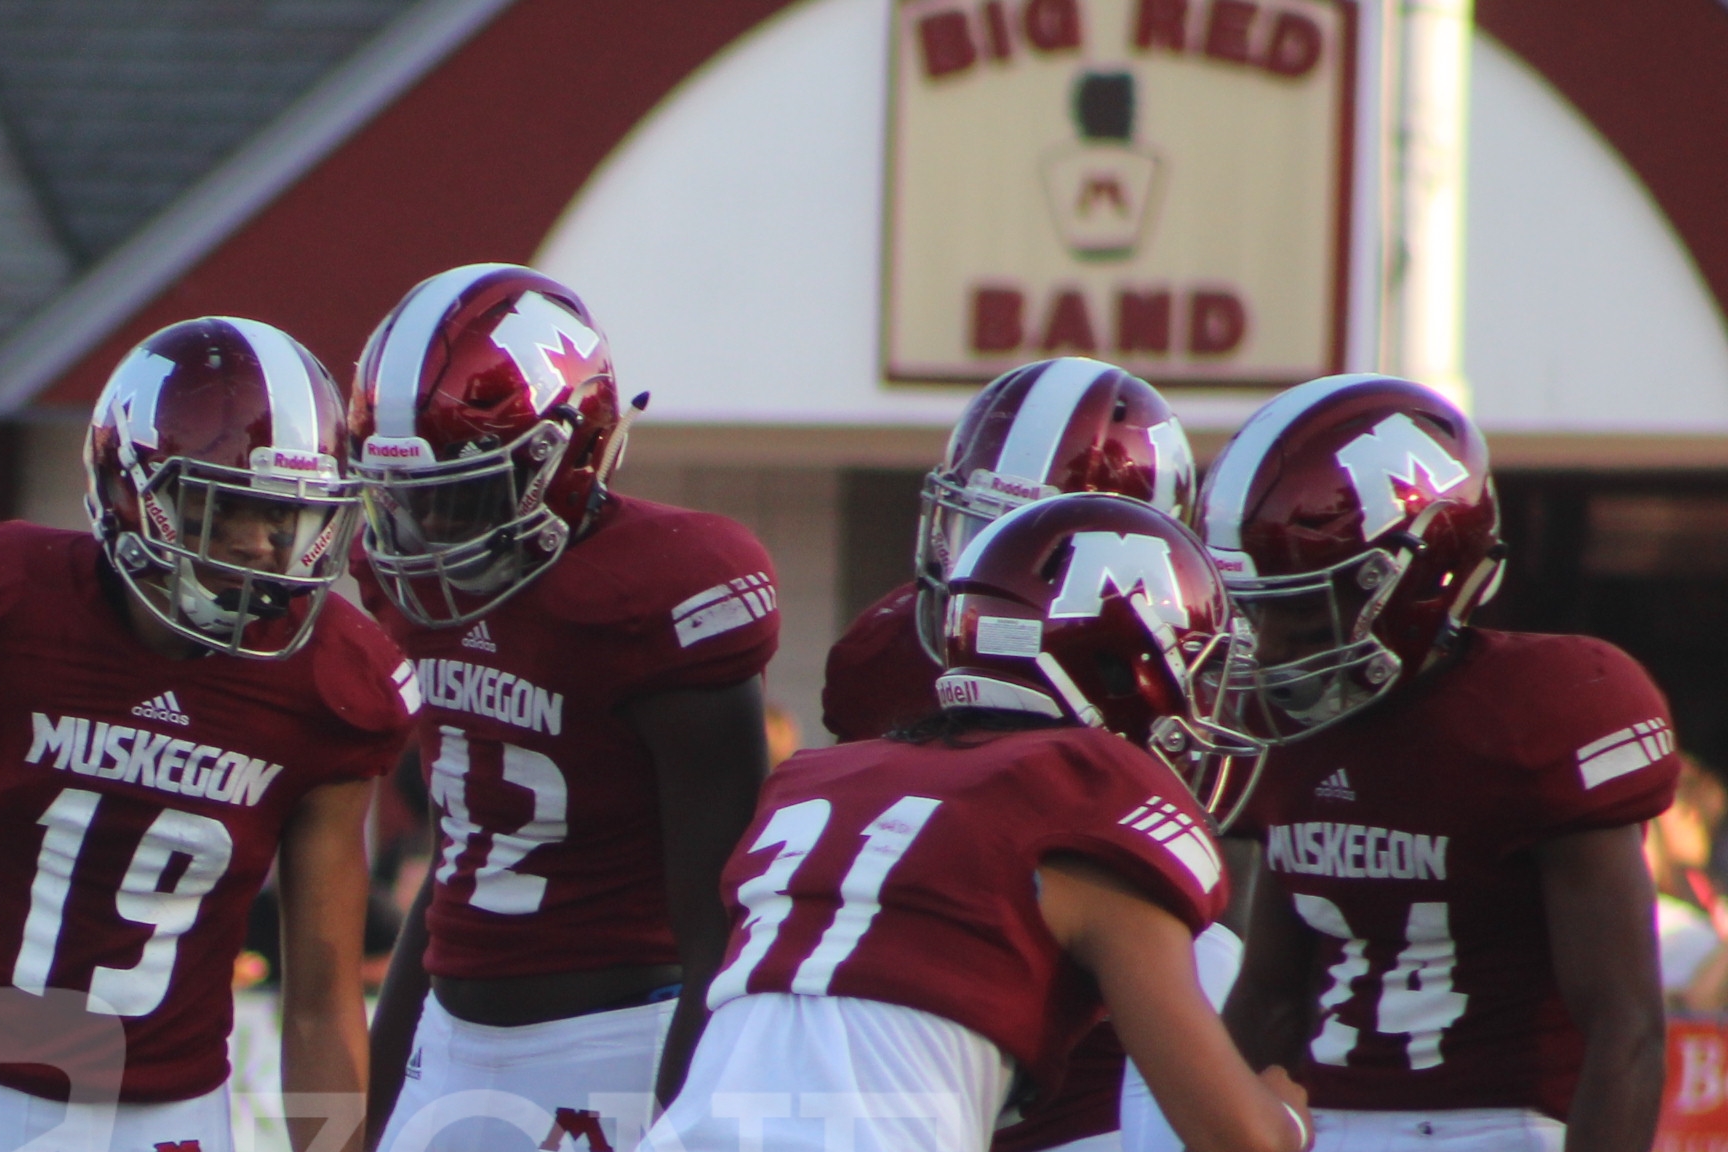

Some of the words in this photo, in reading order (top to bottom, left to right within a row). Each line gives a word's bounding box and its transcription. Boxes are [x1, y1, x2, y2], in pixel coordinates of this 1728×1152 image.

[971, 287, 1246, 356] BAND
[274, 452, 319, 471] Riddell
[367, 443, 420, 457] Riddell
[132, 704, 190, 727] adidas
[406, 658, 564, 736] MUSKEGON
[25, 712, 284, 807] MUSKEGON
[1267, 821, 1449, 881] MUSKEGON
[12, 787, 233, 1017] 19
